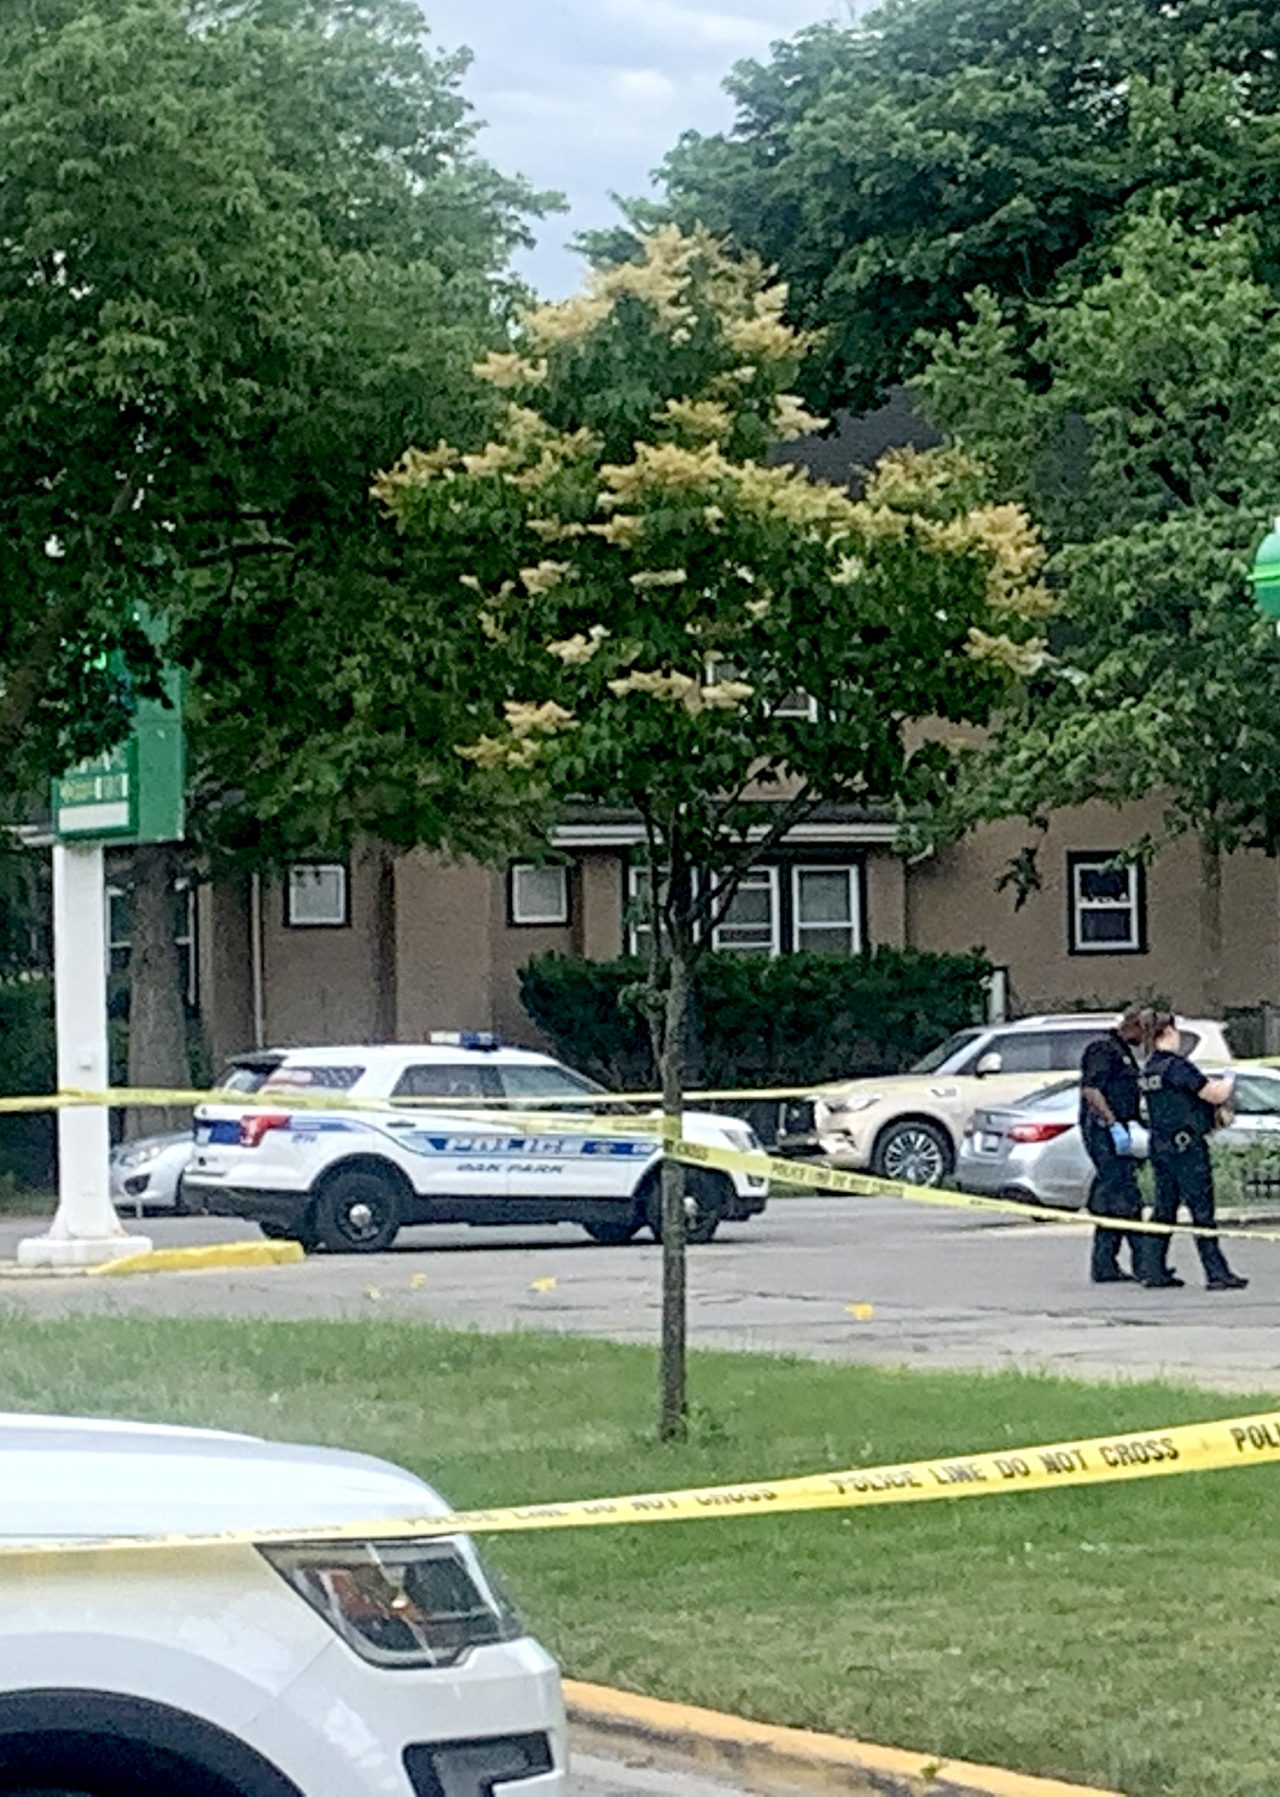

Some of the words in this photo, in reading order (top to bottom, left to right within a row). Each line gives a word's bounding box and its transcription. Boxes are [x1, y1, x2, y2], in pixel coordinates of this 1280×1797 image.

[456, 1162, 501, 1173] OAK
[507, 1163, 566, 1174] PARK
[828, 1469, 923, 1496] POLICE
[928, 1461, 988, 1486] LINE
[992, 1456, 1032, 1480] DO
[1038, 1448, 1089, 1474] NOT
[1098, 1436, 1181, 1470] CROSS
